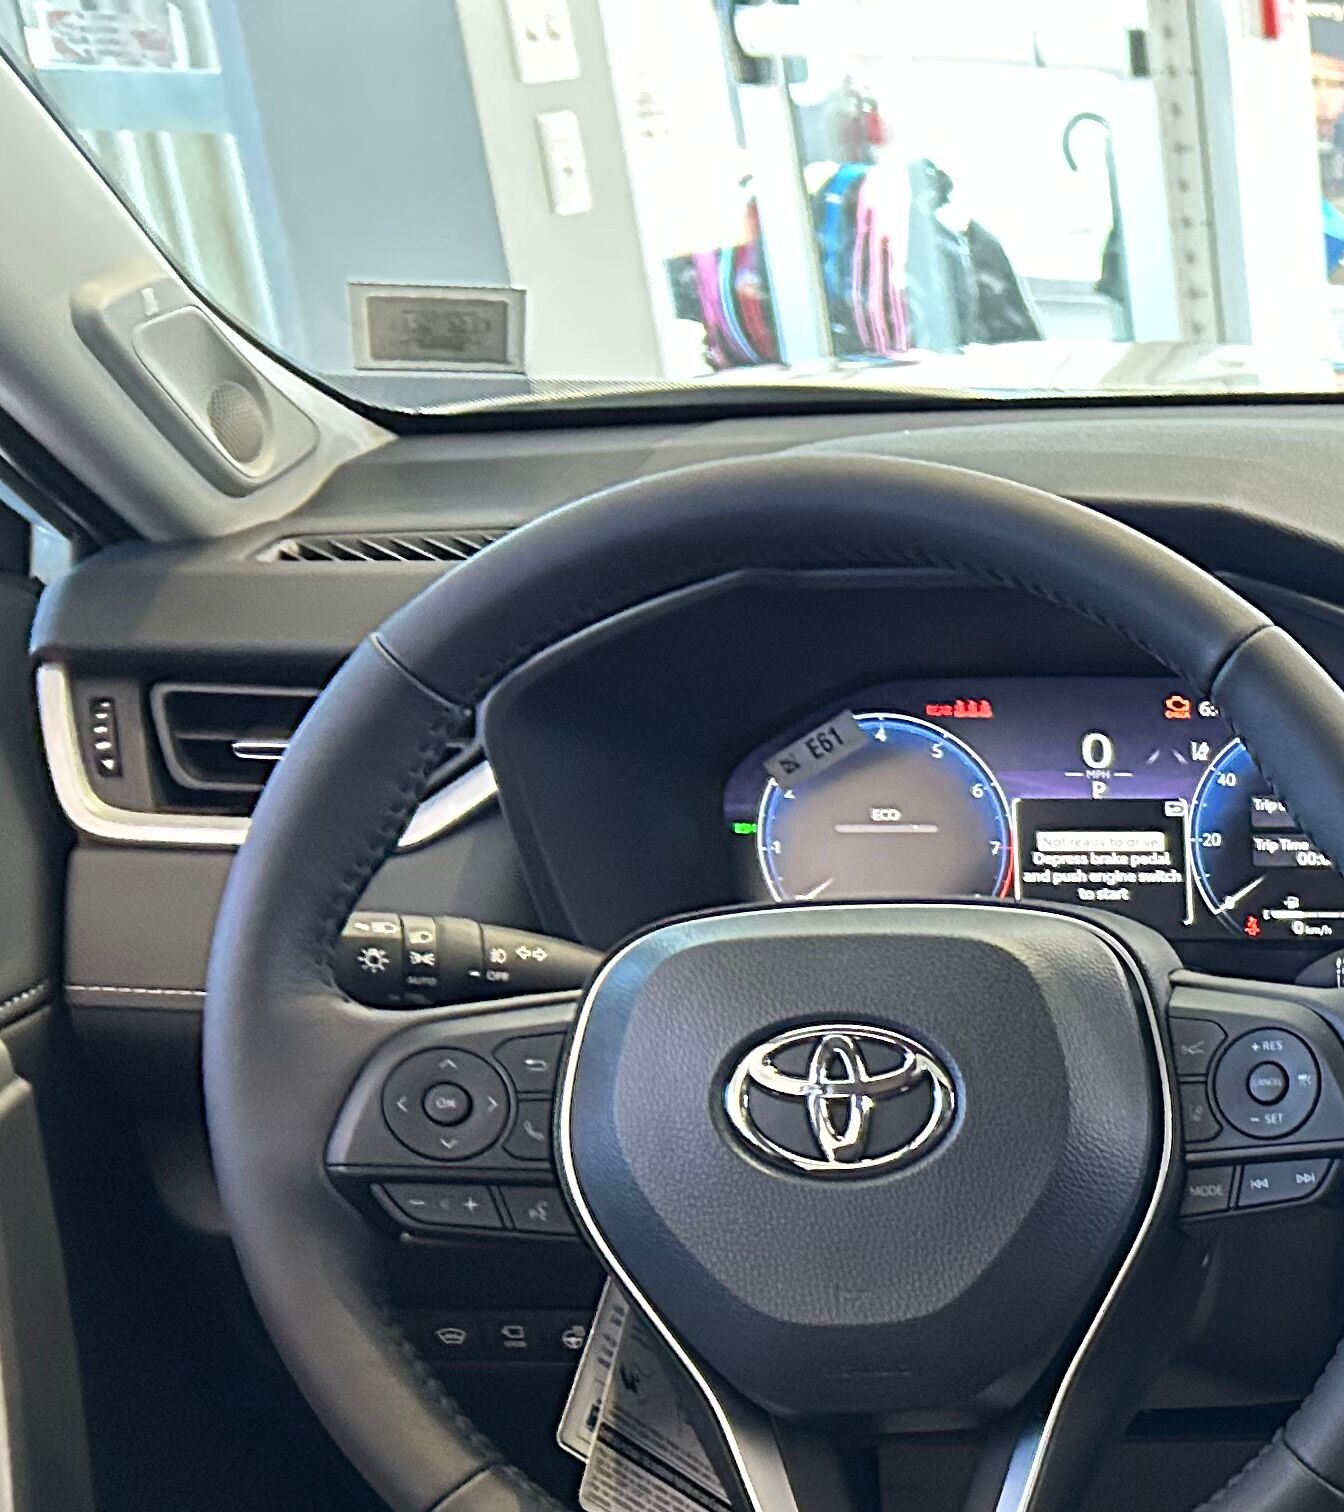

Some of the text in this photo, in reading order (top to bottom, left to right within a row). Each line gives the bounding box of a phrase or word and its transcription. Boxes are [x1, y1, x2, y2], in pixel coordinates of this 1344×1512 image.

[874, 727, 887, 742] 4
[805, 727, 845, 761] E61
[931, 742, 944, 759] 5
[1081, 732, 1114, 769] 0
[1086, 769, 1112, 780] MPH
[1217, 772, 1237, 787] 40
[970, 783, 985, 799] 6
[1092, 780, 1108, 800] P
[1252, 797, 1278, 814] Trip
[870, 807, 902, 822] ECO
[1202, 832, 1223, 847] 20
[1253, 837, 1310, 854] Trip Time
[989, 840, 1001, 856] 7
[1032, 851, 1171, 868] Depress brake pedal
[1022, 870, 1183, 886] and push engine switch
[1077, 887, 1130, 901] to start
[1262, 1040, 1283, 1051] RES
[1264, 1113, 1284, 1124] SET
[1189, 1184, 1224, 1198] MODE
